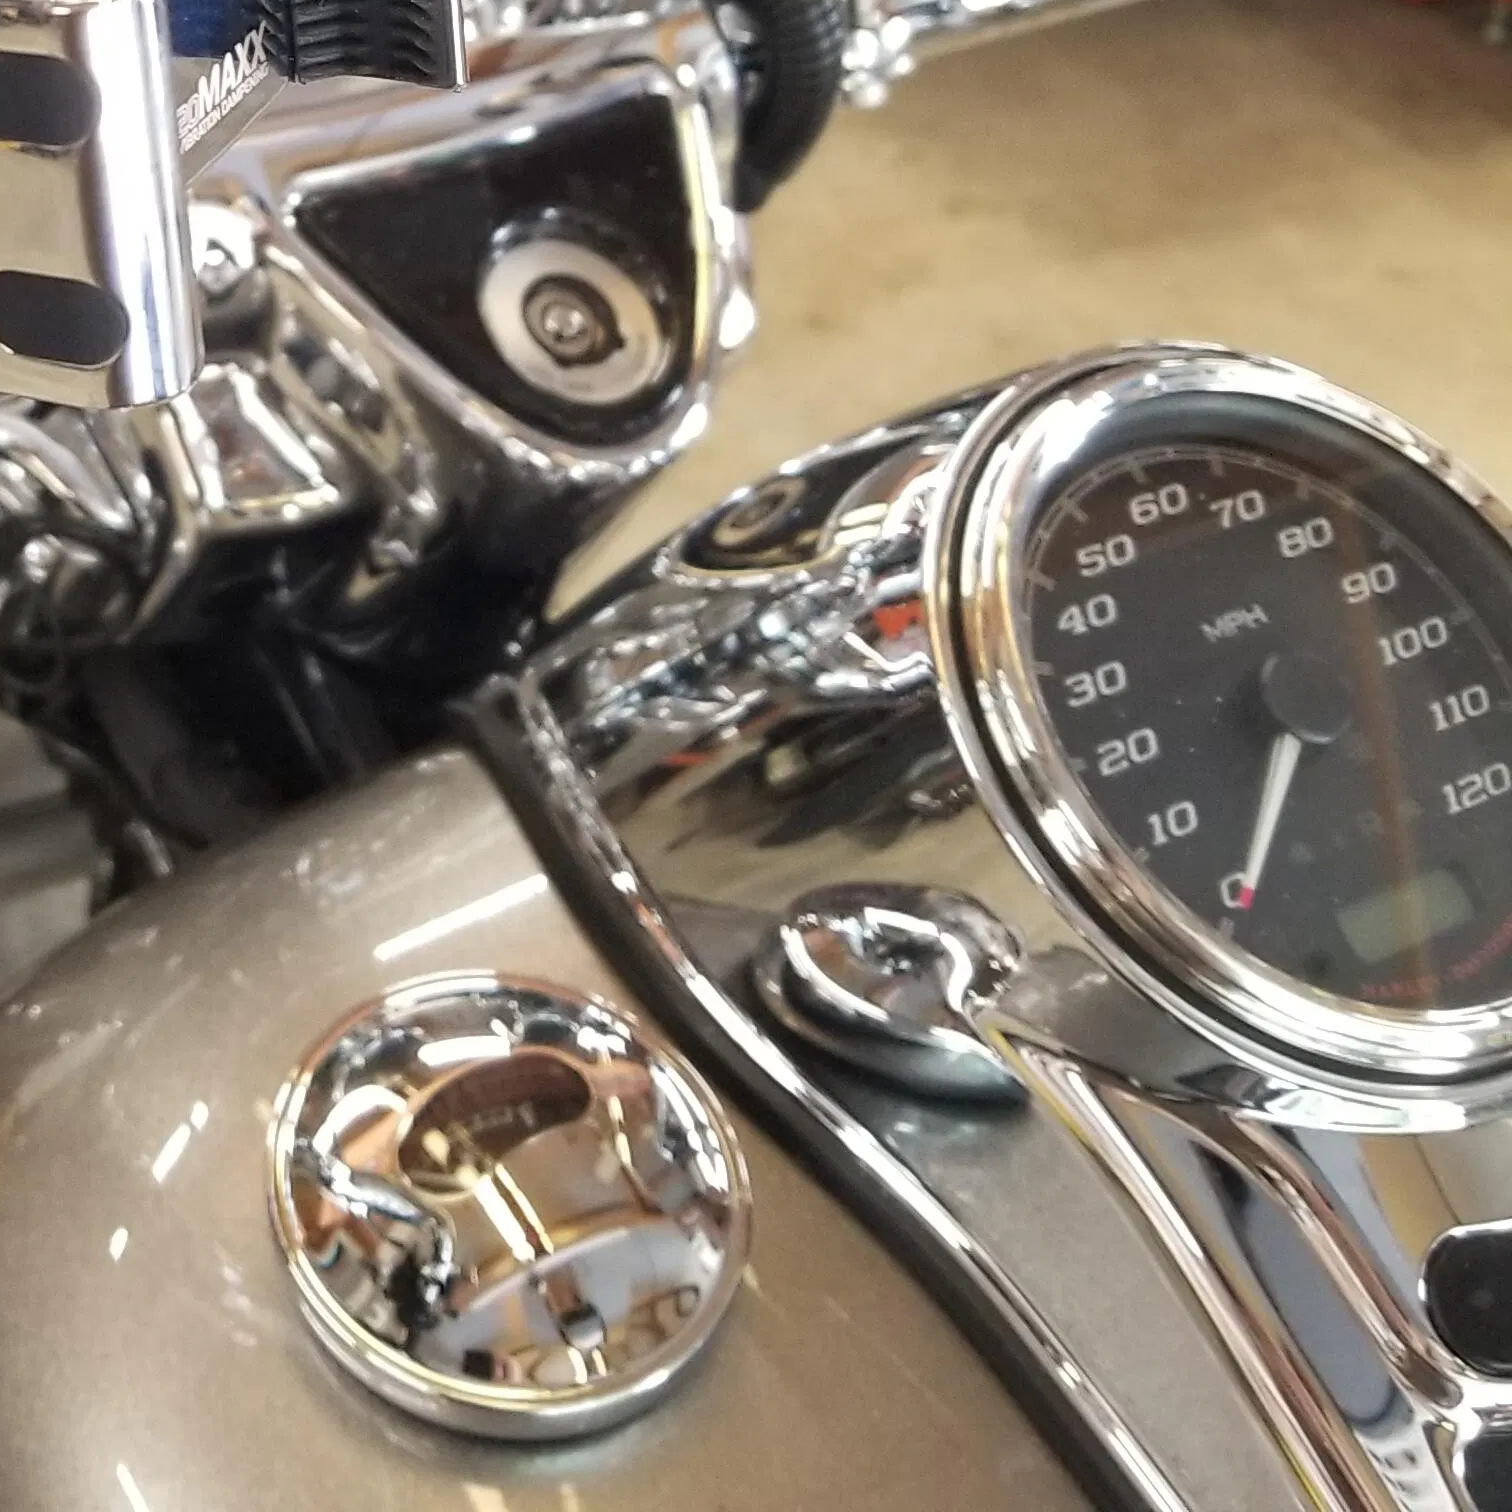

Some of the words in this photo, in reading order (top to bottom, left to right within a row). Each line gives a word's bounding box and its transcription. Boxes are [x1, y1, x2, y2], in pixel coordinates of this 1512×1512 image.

[1129, 482, 1187, 525] 60
[1209, 489, 1266, 528] 70
[1075, 533, 1136, 577] 50
[1276, 517, 1334, 558] 80
[1341, 561, 1397, 604] 90
[1056, 593, 1119, 636] 40
[1200, 603, 1271, 643] MPH
[1377, 616, 1449, 666] 100
[1063, 660, 1128, 707] 30
[1428, 683, 1491, 734] 110
[1096, 727, 1160, 777] 20
[1440, 761, 1512, 816] 120
[1147, 800, 1199, 846] 10
